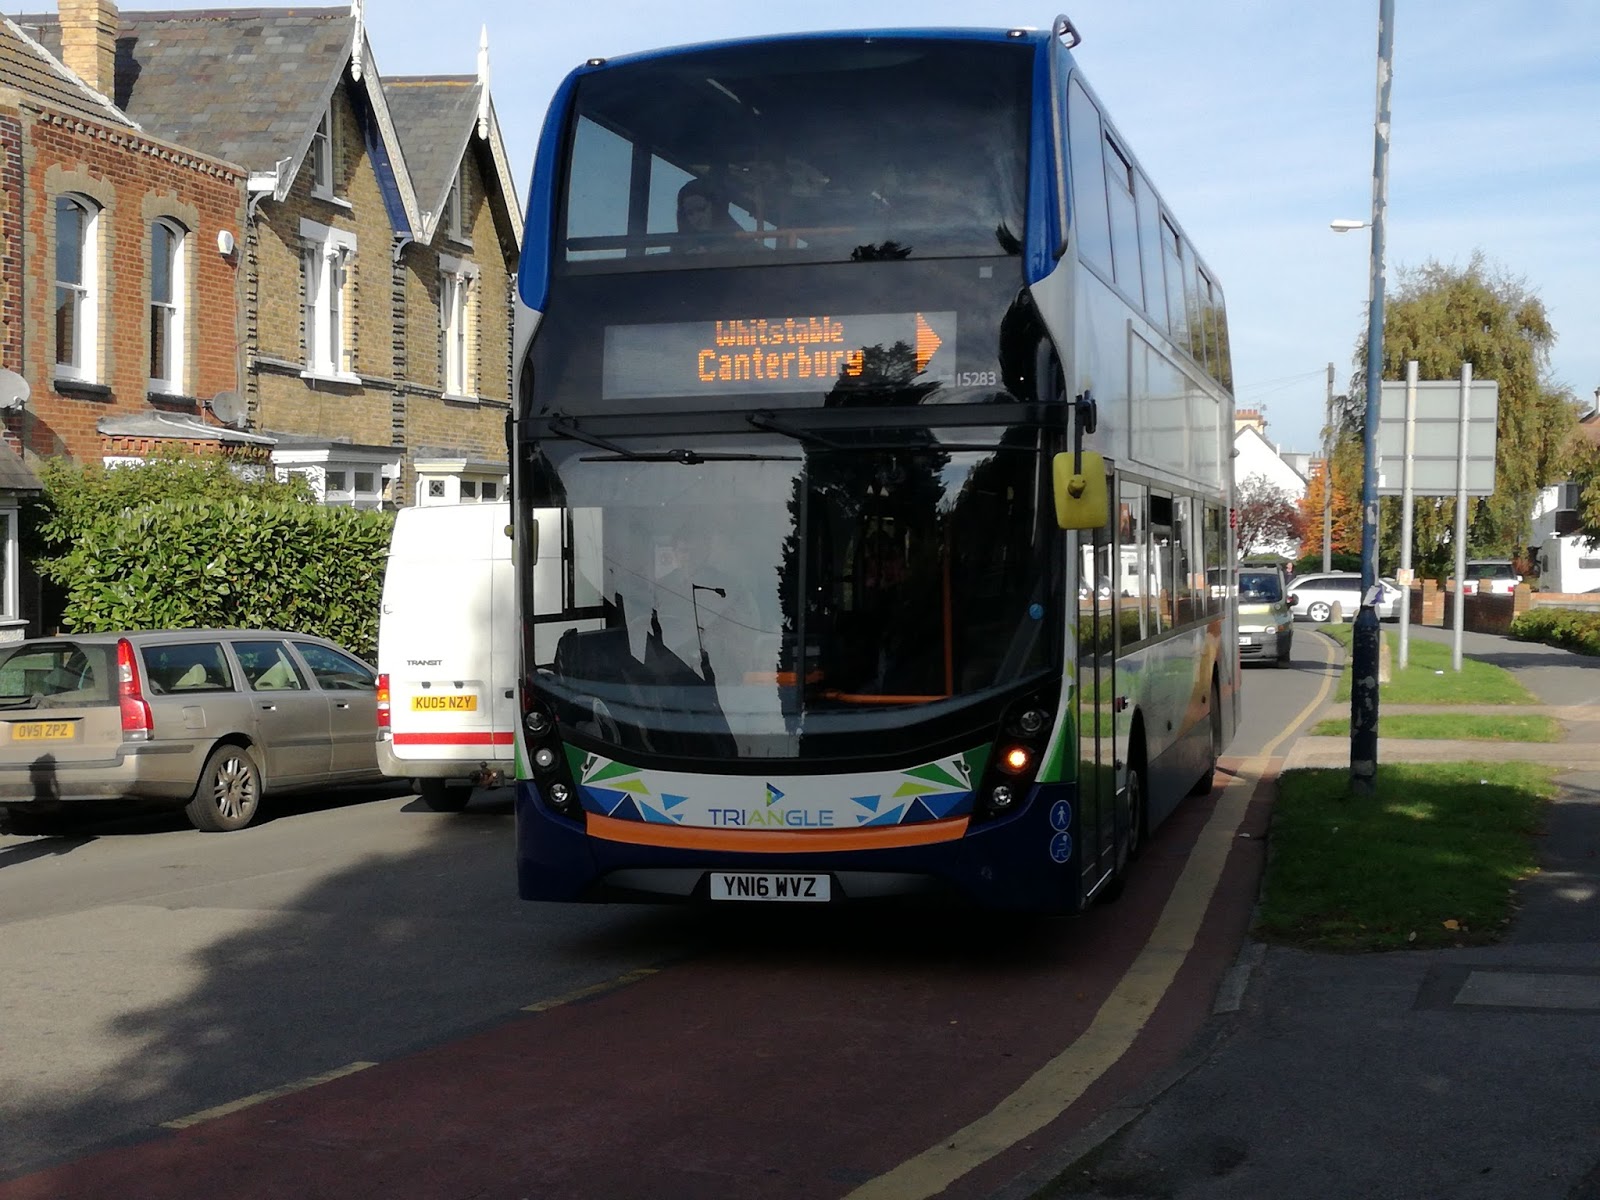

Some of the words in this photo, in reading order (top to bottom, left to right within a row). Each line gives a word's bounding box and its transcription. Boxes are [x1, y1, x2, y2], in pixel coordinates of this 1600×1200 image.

[715, 316, 844, 347] Whitstable
[698, 346, 863, 381] Canterbury
[957, 371, 997, 387] 15283
[416, 697, 446, 709] KU05
[448, 696, 472, 708] NZY
[45, 723, 68, 736] ZPZ
[708, 809, 834, 826] TRIANGLE
[724, 876, 769, 896] YN16
[776, 877, 817, 897] WVZ
